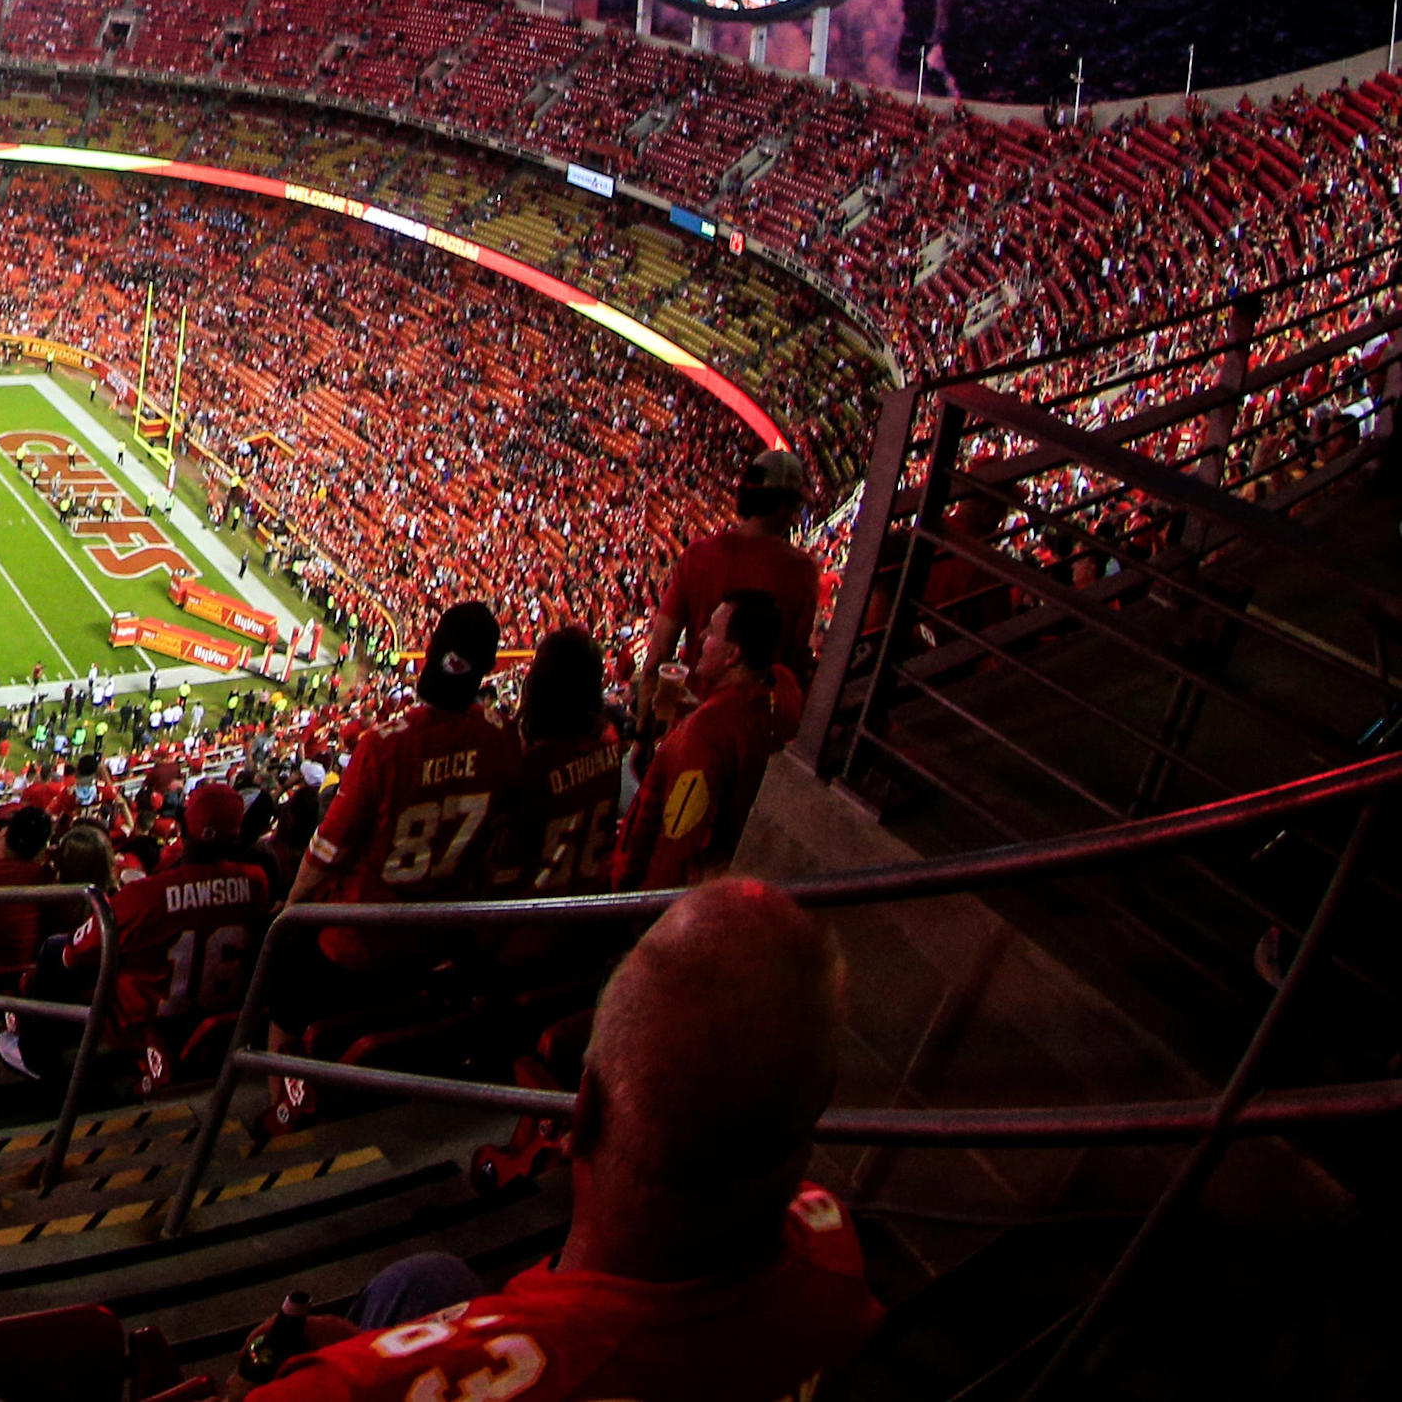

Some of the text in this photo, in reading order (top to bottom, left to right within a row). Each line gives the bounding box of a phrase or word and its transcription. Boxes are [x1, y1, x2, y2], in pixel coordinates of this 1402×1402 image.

[285, 183, 480, 262] WELCOME TO STADIUM
[193, 645, 229, 666] HyVee
[421, 749, 478, 788] KELCE
[380, 791, 491, 885] 87
[165, 876, 251, 914] DAWSON
[156, 924, 249, 1018] 16
